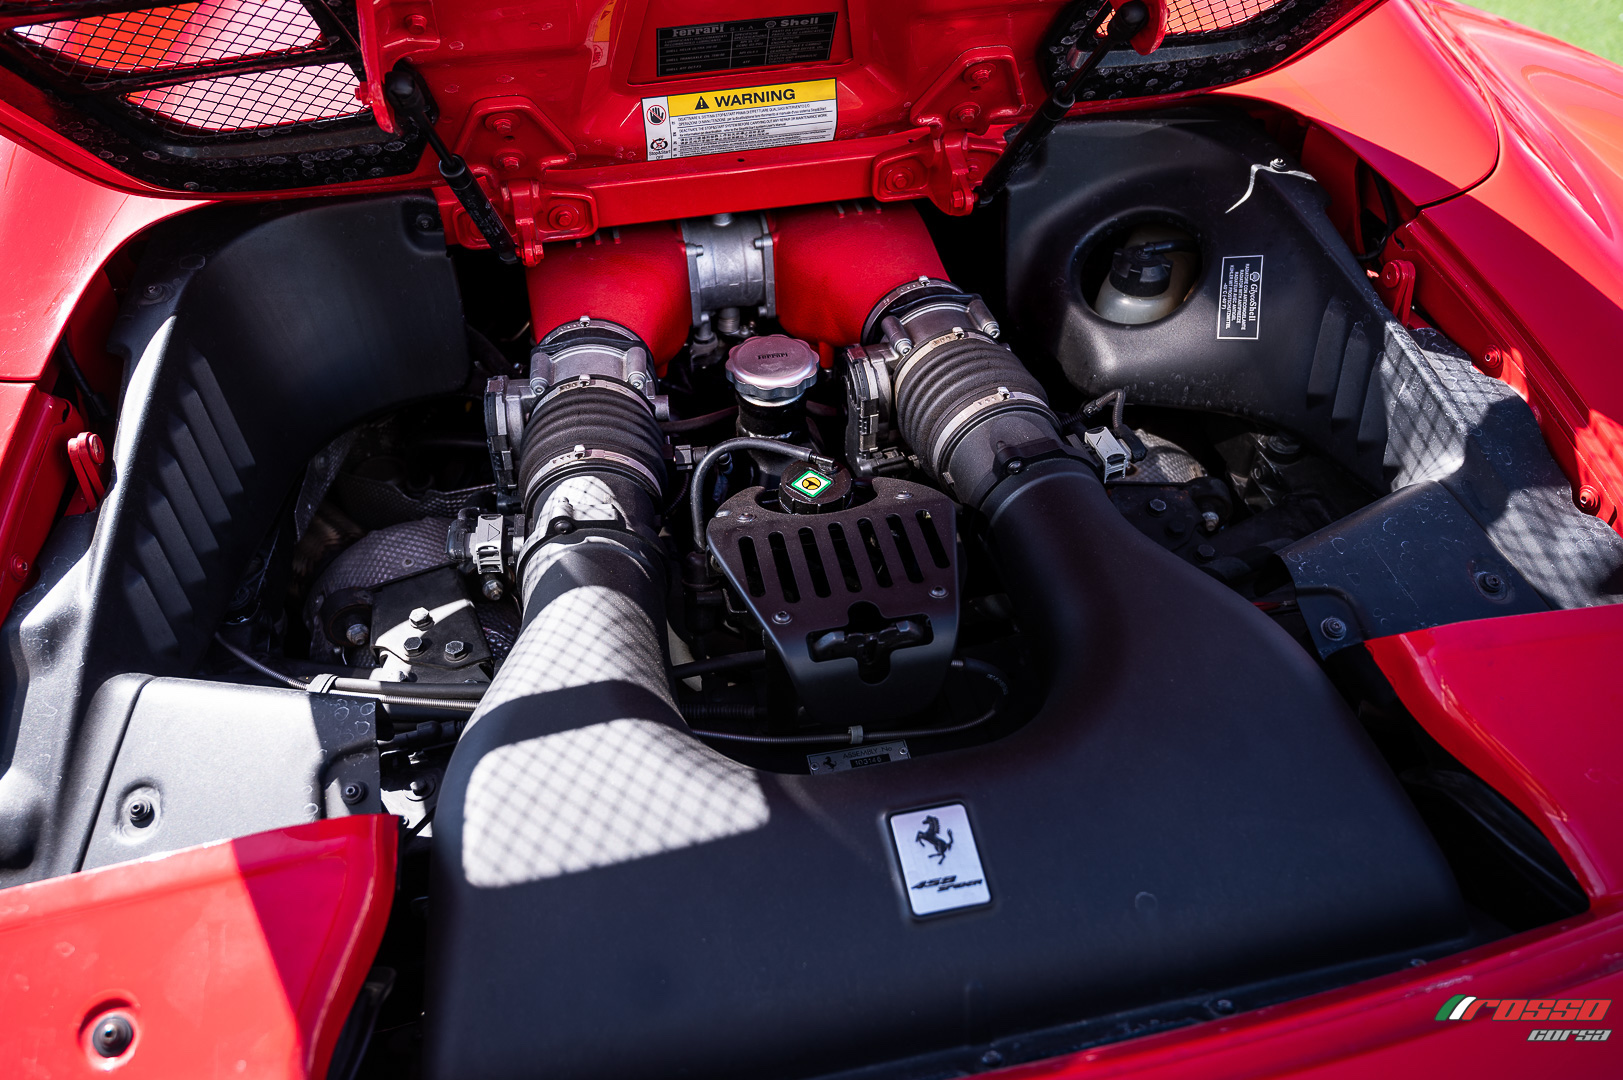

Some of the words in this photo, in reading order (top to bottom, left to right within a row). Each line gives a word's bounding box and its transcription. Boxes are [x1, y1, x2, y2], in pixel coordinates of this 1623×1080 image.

[780, 17, 819, 27] Shell
[672, 25, 724, 37] Ferrari
[714, 88, 796, 108] WARNING
[1249, 284, 1258, 321] GlycoShell
[757, 352, 788, 360] Ferrari
[842, 747, 879, 759] ASSEMBLY
[910, 875, 957, 890] 458
